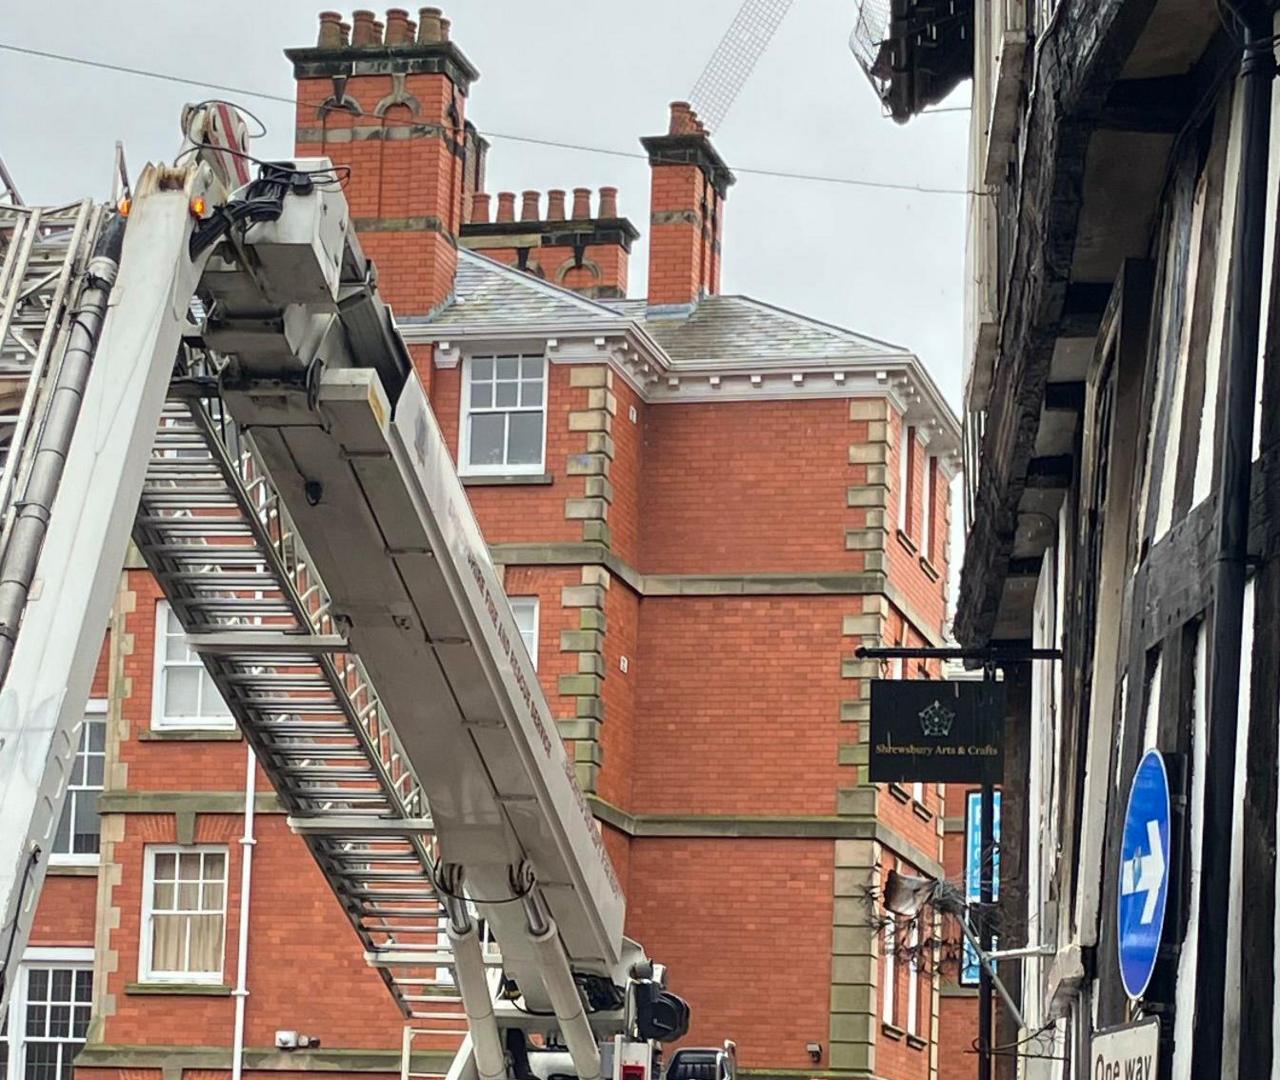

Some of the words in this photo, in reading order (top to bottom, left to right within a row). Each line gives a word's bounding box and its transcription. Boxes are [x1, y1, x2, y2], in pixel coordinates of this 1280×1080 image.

[876, 744, 933, 756] Shrewsbury
[935, 745, 956, 755] Arts
[957, 746, 965, 755] &
[968, 744, 998, 756] Crafts
